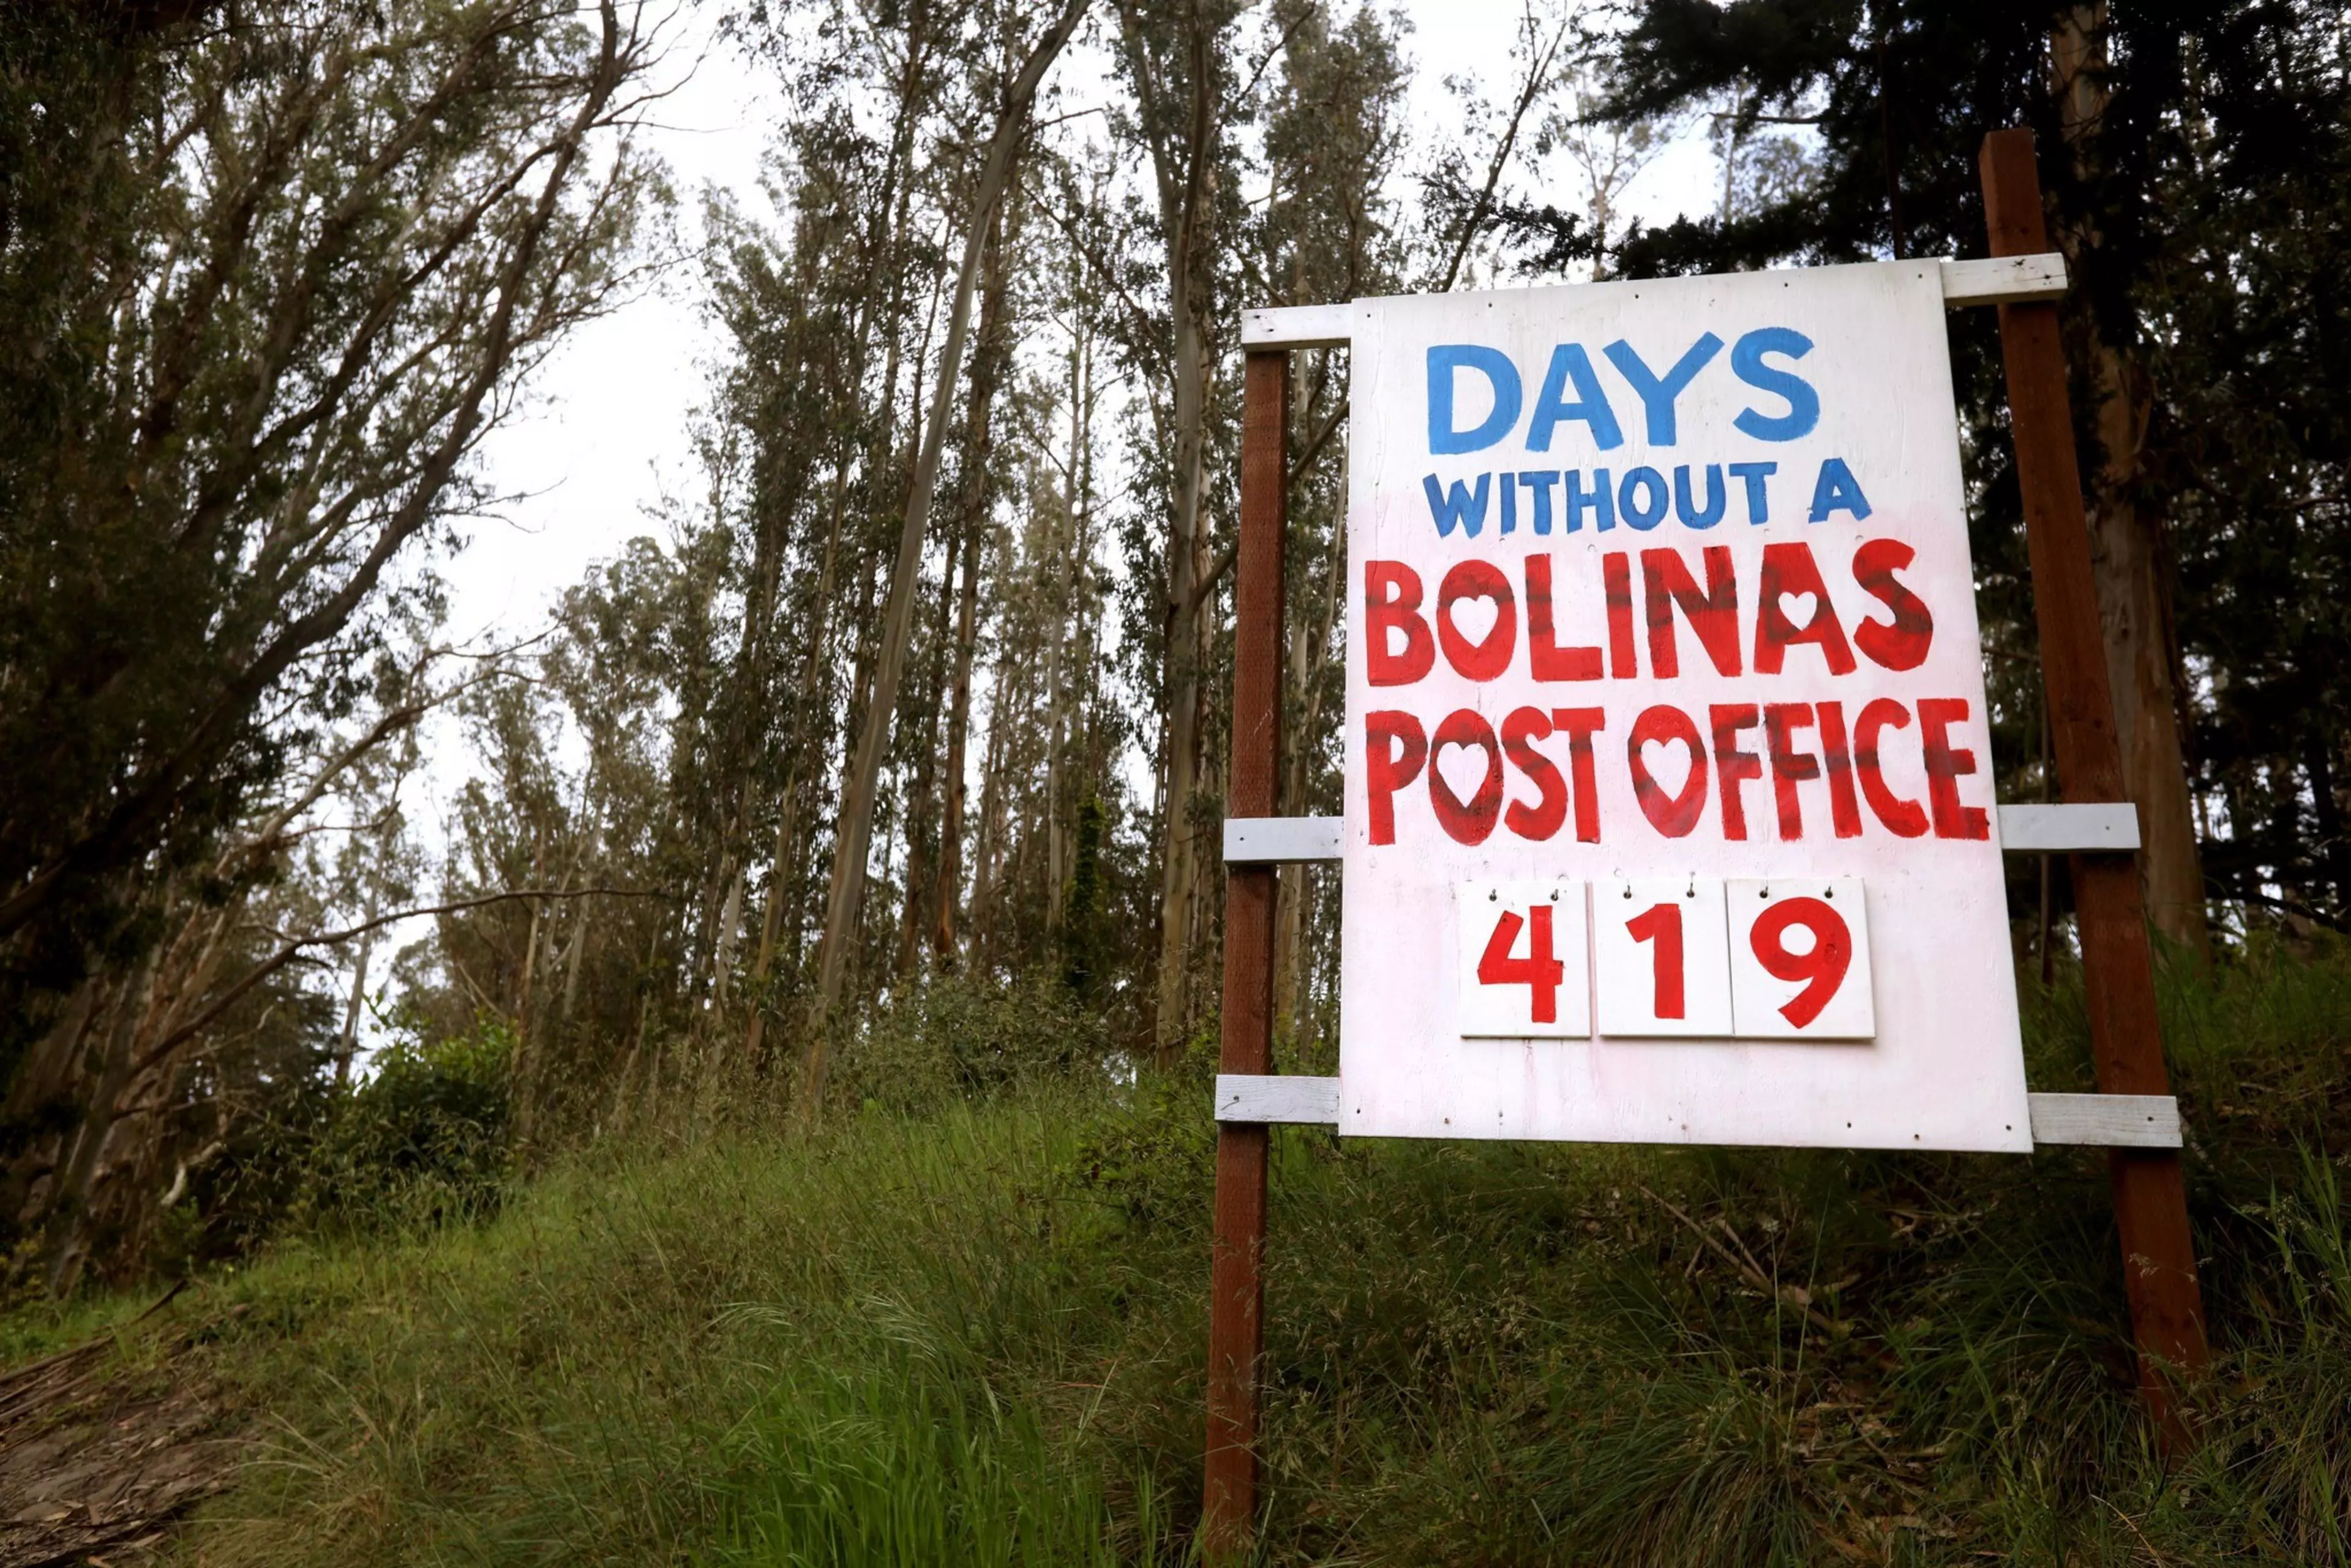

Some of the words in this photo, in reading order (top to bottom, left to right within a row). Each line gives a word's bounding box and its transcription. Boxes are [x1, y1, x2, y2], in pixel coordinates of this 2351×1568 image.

[1427, 326, 1820, 456] DAYS
[1422, 461, 1777, 539] WITHOUT
[1808, 456, 1873, 524] A
[1365, 538, 1933, 687] BOLINAS
[1365, 704, 1605, 846] POST
[1627, 696, 1991, 842] OFFICE
[1477, 895, 1852, 1029] 419
